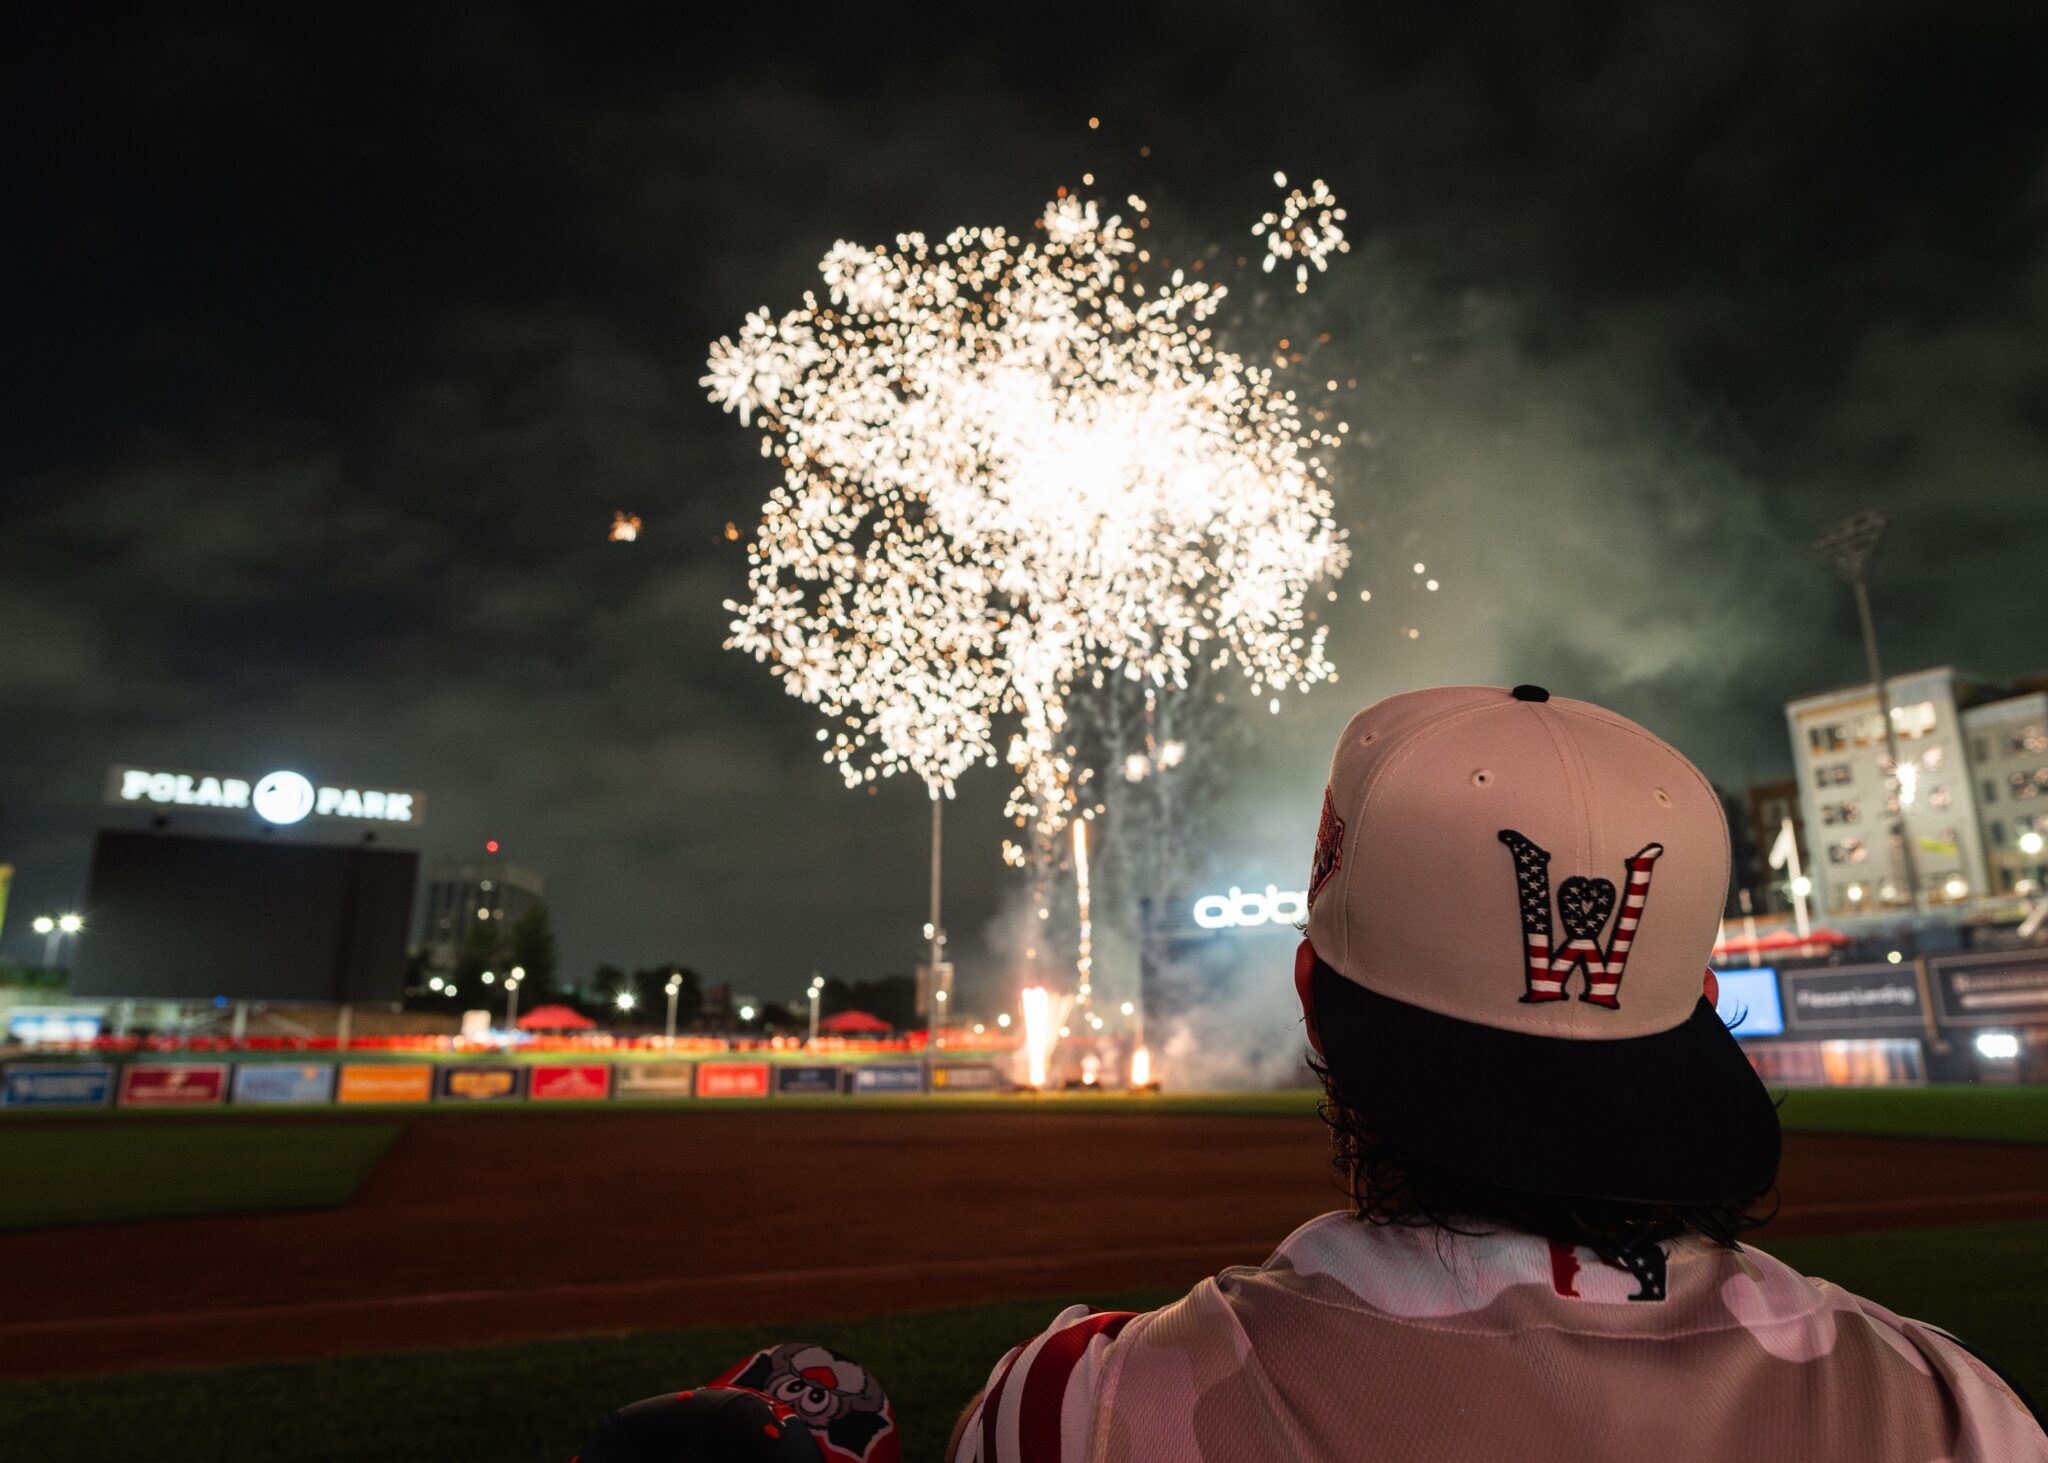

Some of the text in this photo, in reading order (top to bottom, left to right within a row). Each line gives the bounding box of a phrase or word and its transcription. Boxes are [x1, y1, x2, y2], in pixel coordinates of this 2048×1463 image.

[121, 770, 413, 821] POLAR PARK
[1194, 884, 1308, 928] abb
[1497, 829, 1664, 1010] W
